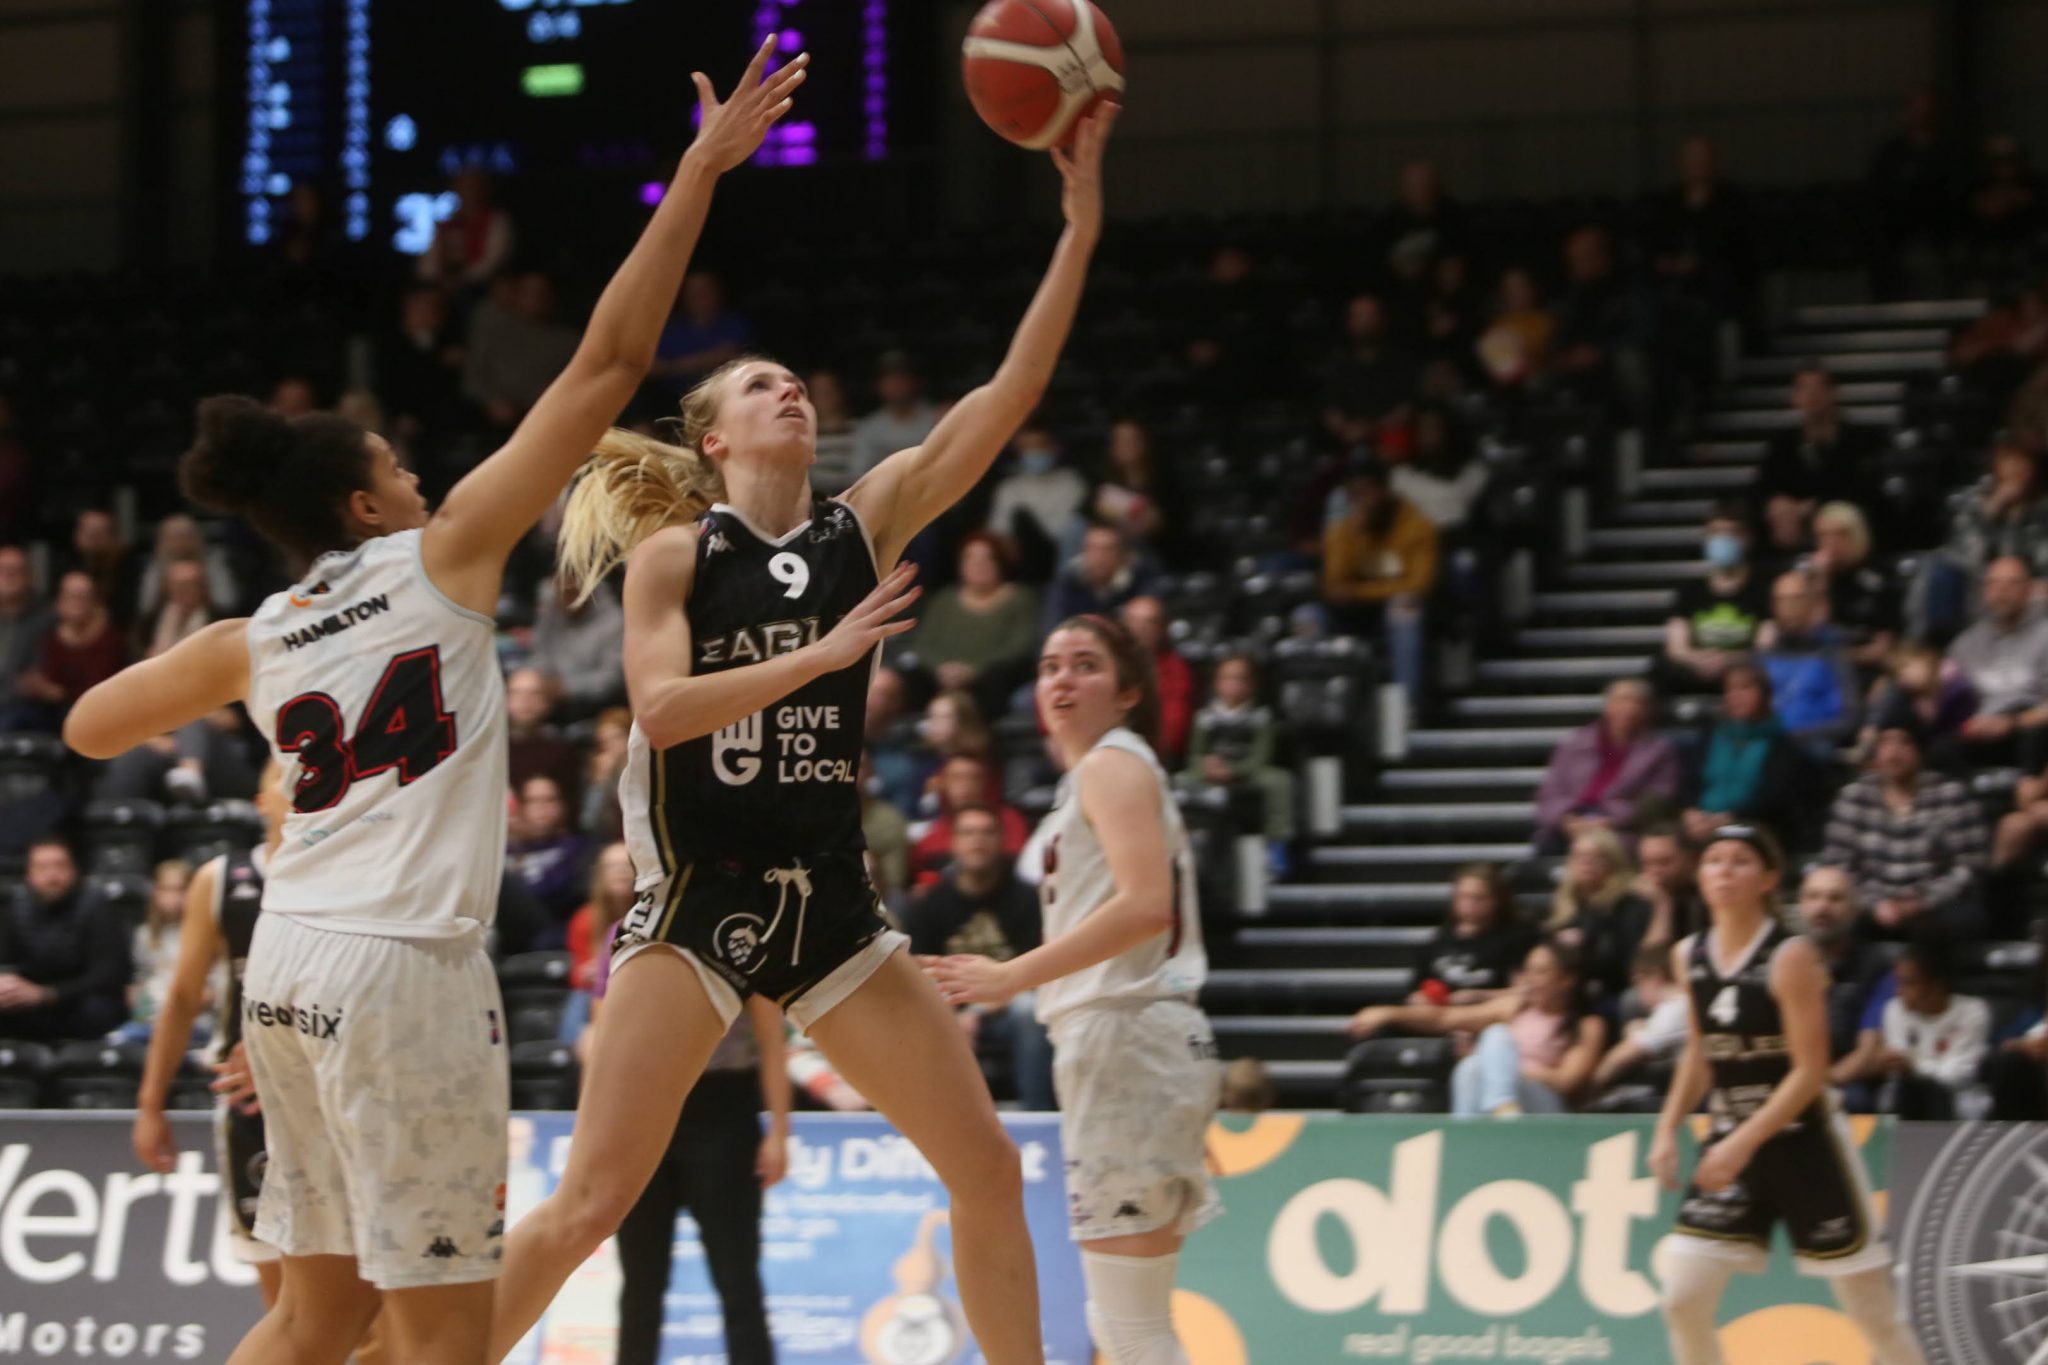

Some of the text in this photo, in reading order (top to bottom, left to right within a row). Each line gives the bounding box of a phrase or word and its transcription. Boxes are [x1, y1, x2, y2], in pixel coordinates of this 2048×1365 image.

[768, 551, 810, 599] 9
[281, 594, 389, 651] HAMILTON
[701, 616, 848, 664] EAGL
[276, 643, 457, 814] 34
[776, 706, 840, 730] GIVE
[776, 733, 816, 756] TO
[778, 759, 855, 783] LOCAL
[1707, 983, 1740, 1026] 4
[1267, 1129, 1664, 1318] dot
[0, 1312, 206, 1359] Motors
[1342, 1322, 1612, 1365] real good bagels
